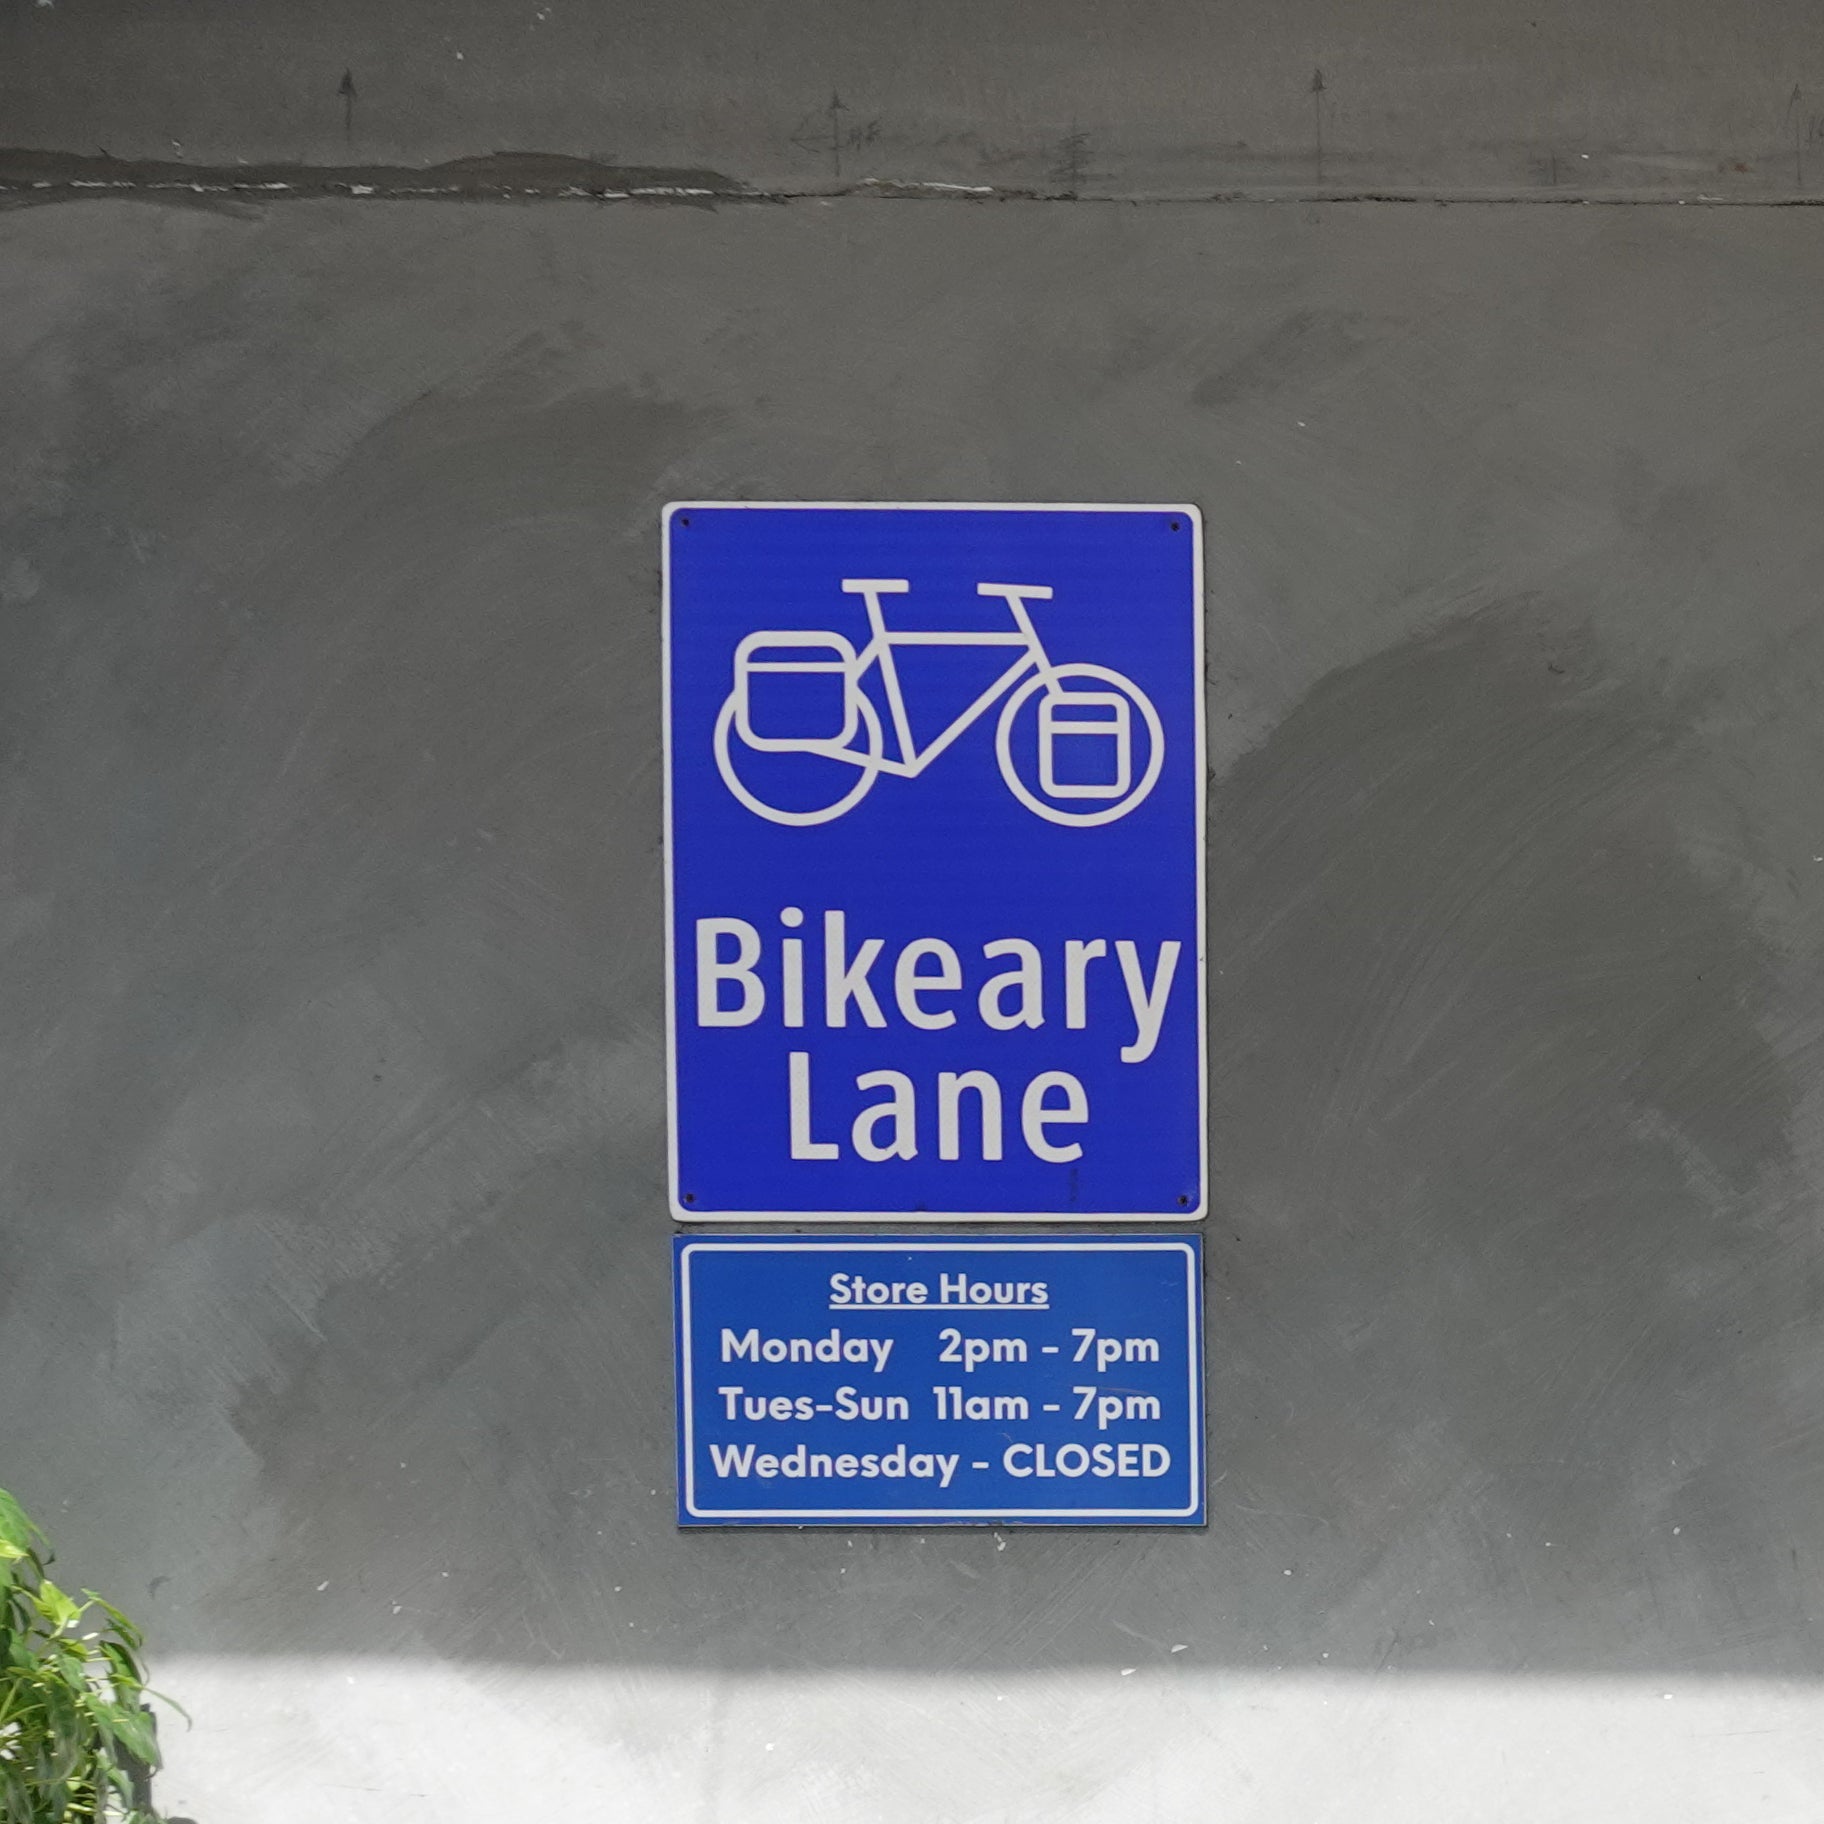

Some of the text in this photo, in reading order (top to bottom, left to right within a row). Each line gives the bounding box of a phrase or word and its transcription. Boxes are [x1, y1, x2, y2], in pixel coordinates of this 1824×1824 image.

[696, 906, 1182, 1063] Bikeary
[788, 1051, 1090, 1163] Lane
[829, 1273, 1049, 1304] Store Hours
[721, 1328, 1160, 1373] Monday 2pm - 7pm
[718, 1385, 1161, 1429] Tues-Sun 11am - 7pm
[709, 1442, 1172, 1487] Wednesday - CLOSED
